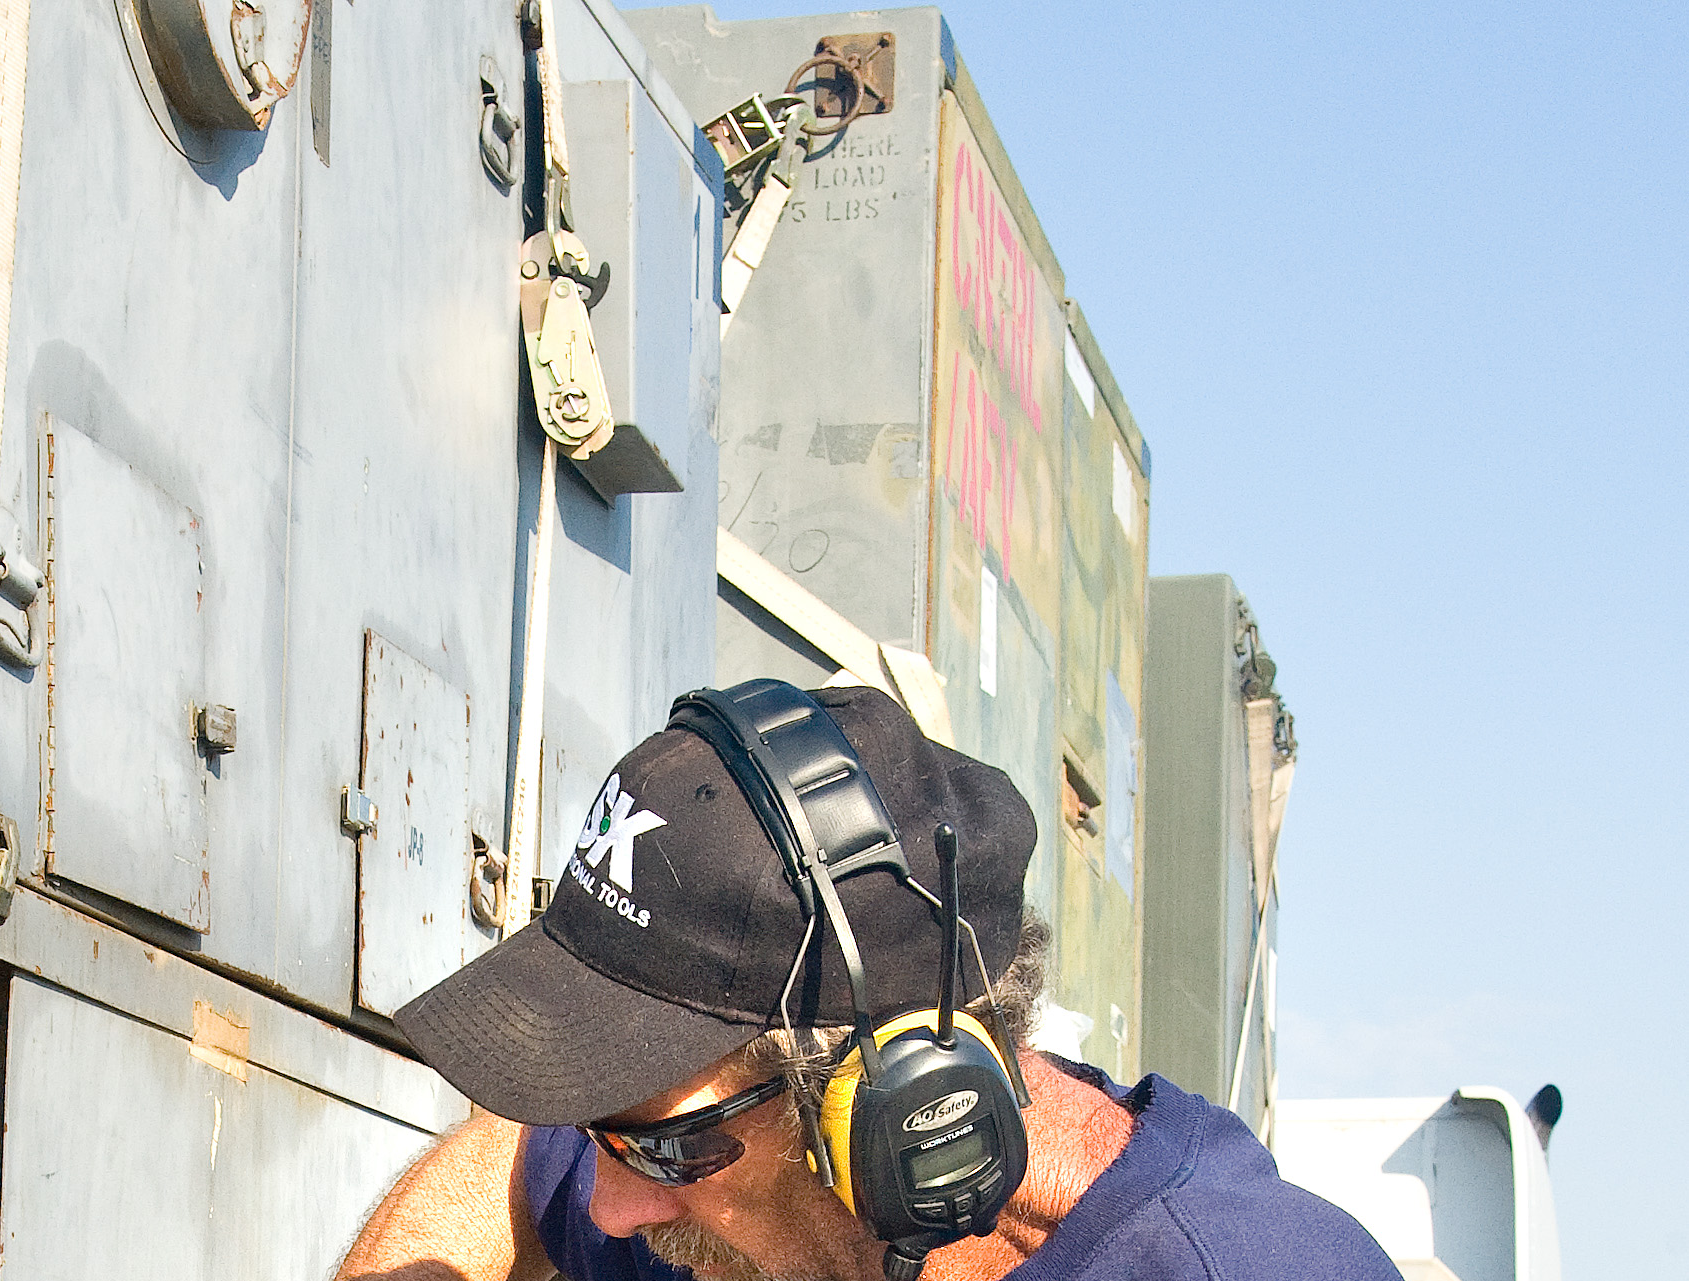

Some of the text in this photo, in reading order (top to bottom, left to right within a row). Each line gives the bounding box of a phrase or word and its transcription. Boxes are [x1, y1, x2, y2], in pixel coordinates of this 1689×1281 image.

[814, 165, 886, 190] LOAD
[825, 197, 880, 221] LBS
[408, 822, 424, 866] JP-8
[597, 882, 652, 928] TOOLS
[910, 1096, 973, 1128] AO Safety
[920, 1124, 974, 1150] WORKTUNES
